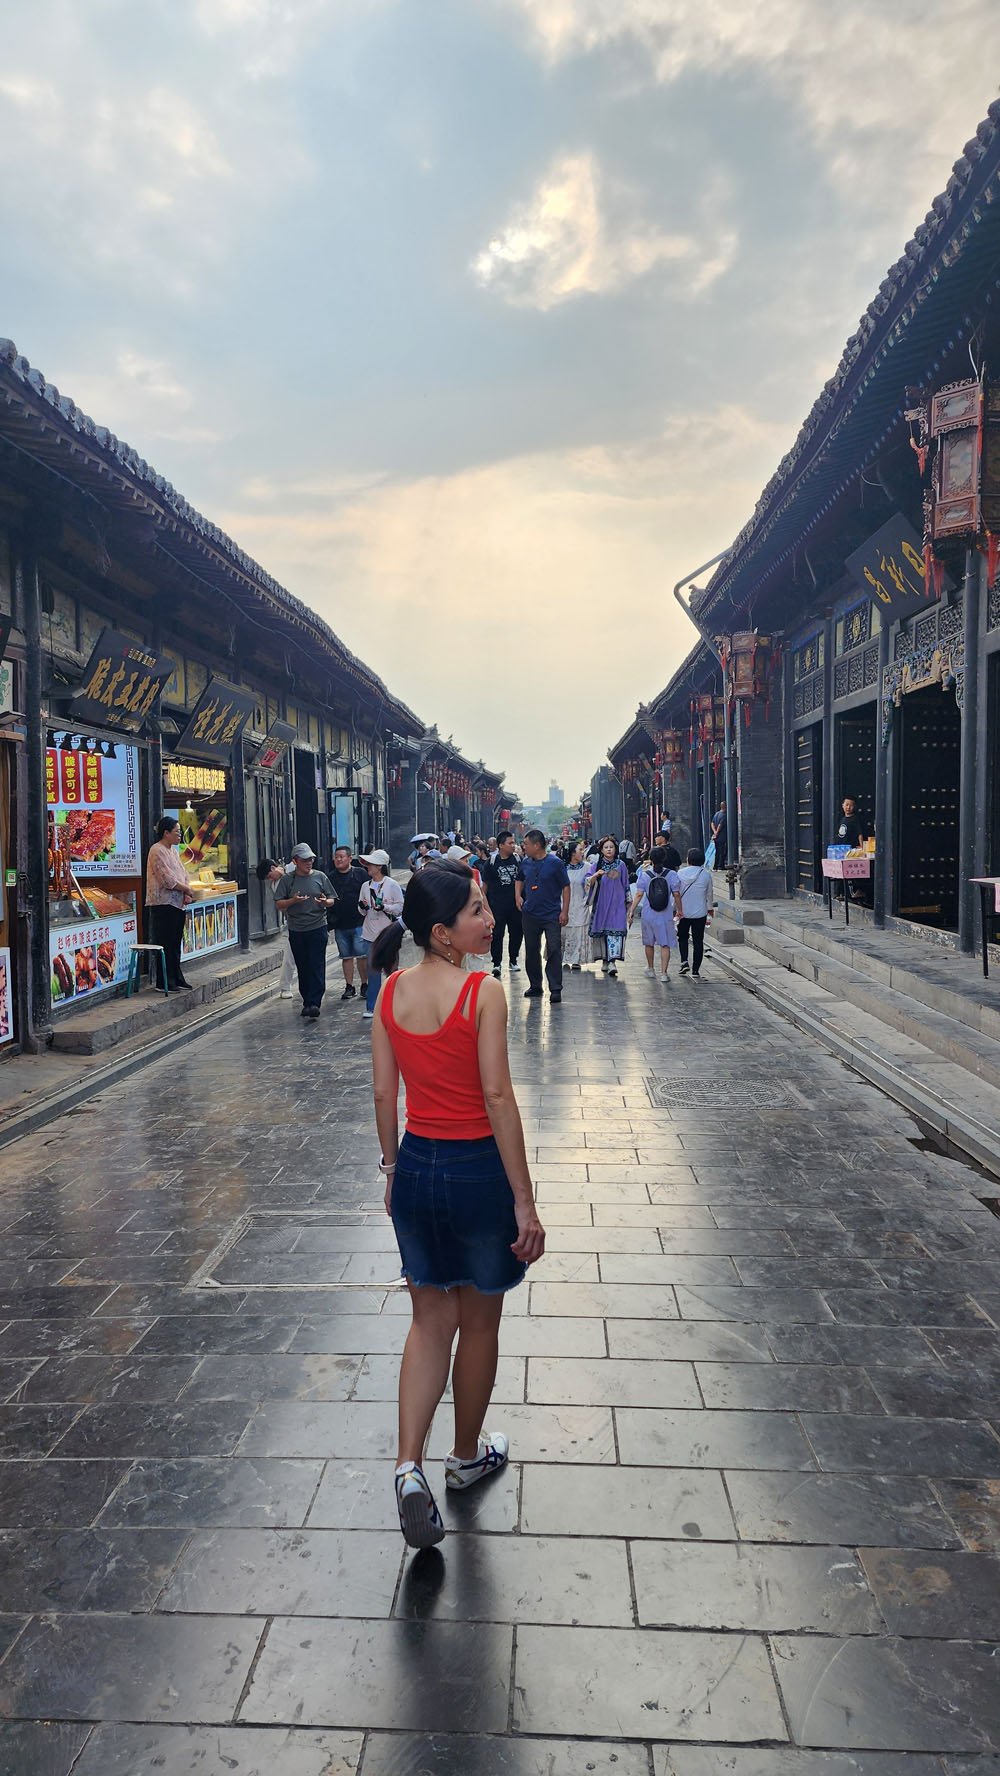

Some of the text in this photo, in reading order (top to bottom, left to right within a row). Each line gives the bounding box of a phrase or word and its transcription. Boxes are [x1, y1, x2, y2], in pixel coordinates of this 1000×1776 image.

[83, 657, 160, 717] 脆皮五花肉
[192, 697, 245, 745] 桂花糕
[86, 755, 98, 802] 越嚼越香
